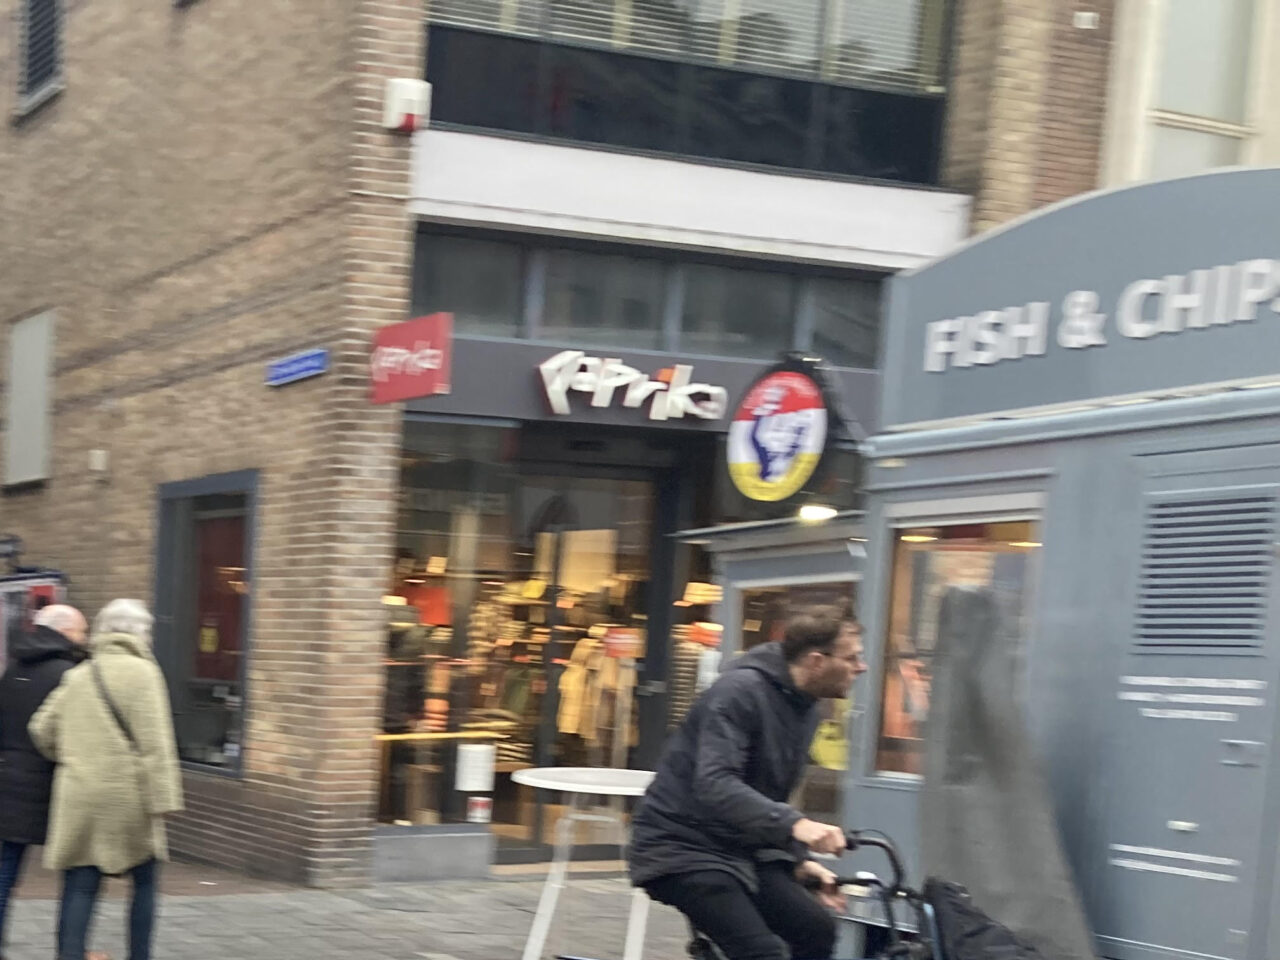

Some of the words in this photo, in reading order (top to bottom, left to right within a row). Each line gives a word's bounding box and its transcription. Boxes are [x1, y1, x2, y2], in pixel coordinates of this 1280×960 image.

[924, 301, 1050, 373] FISH
[1058, 290, 1107, 349] &
[1117, 259, 1280, 338] CHIP
